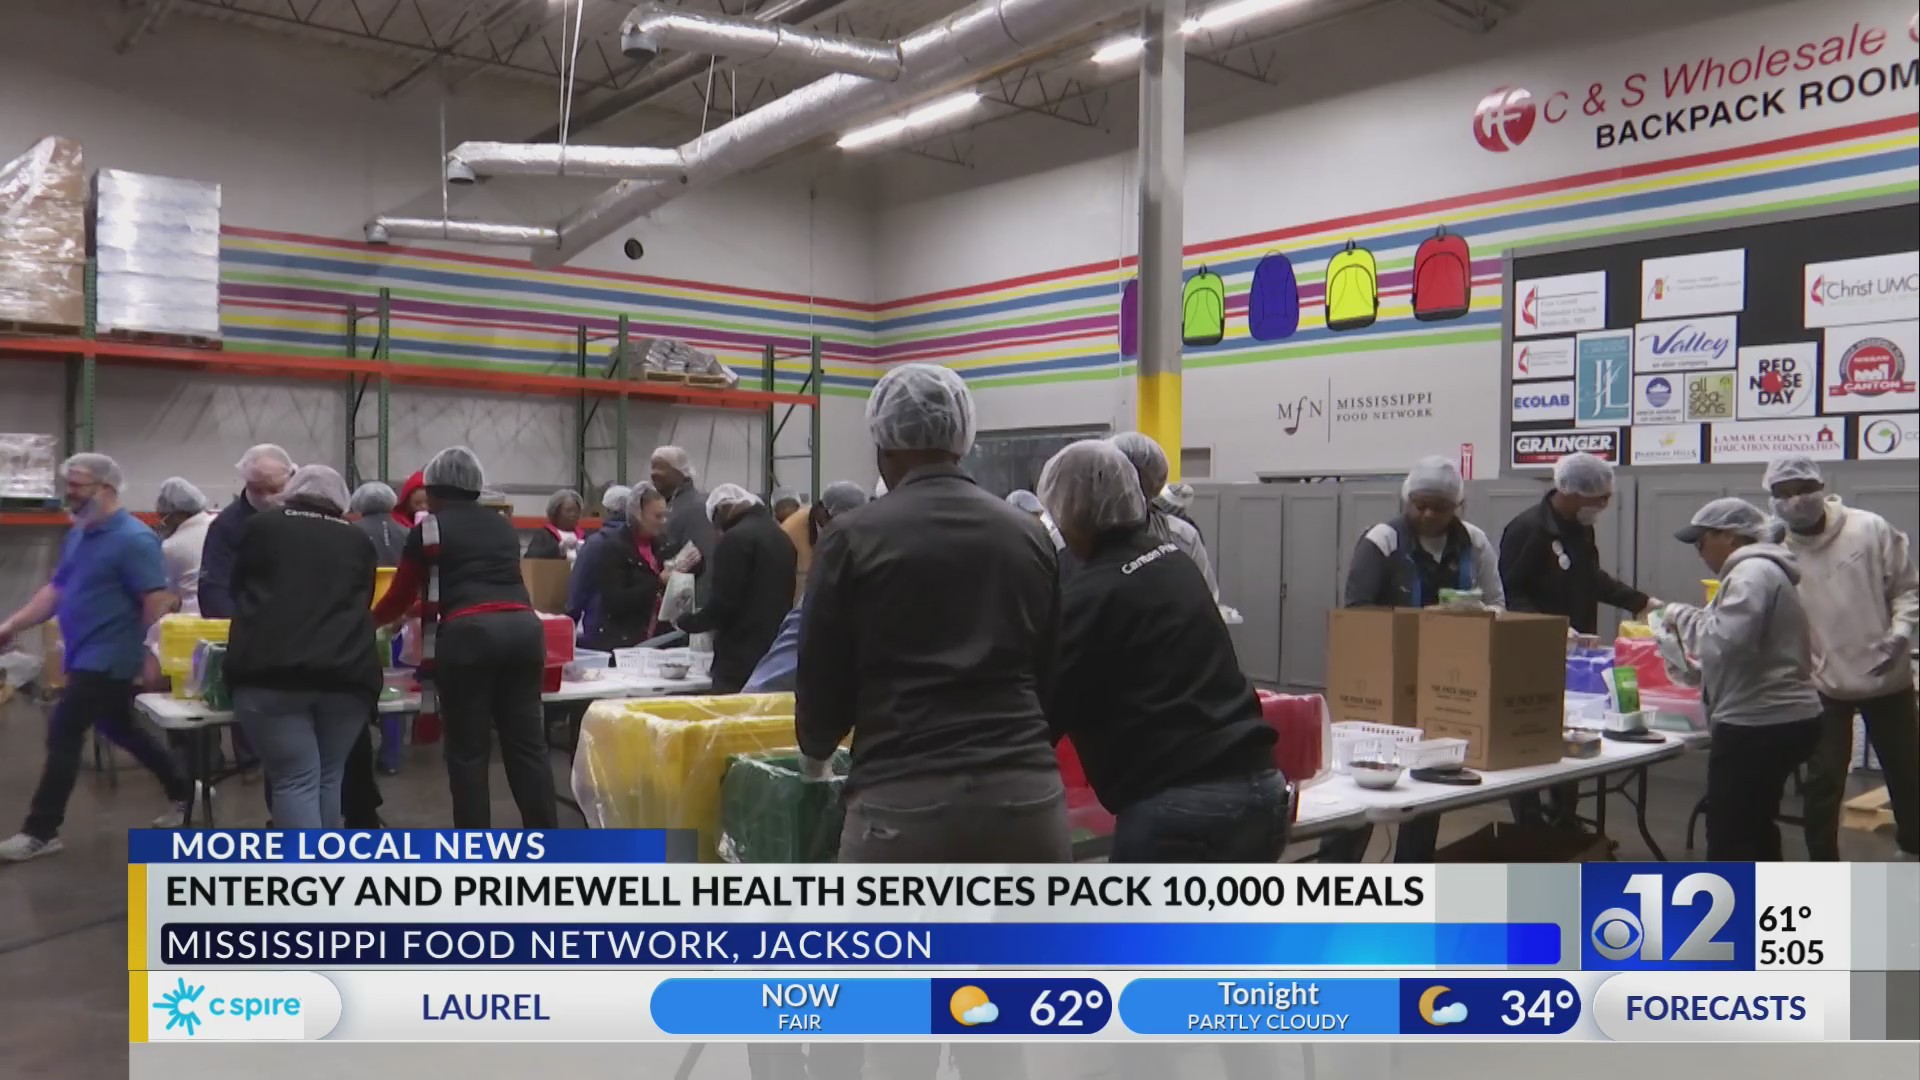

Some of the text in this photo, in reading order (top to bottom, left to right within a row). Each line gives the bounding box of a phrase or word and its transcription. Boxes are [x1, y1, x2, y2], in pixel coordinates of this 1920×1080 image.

[1543, 91, 1569, 124] C
[1582, 82, 1606, 116] &
[1621, 73, 1648, 107] S
[1663, 22, 1887, 98] Wholesale
[1596, 58, 1919, 149] BACKPACK ROOM
[1827, 273, 1919, 300] Christ UMC
[1640, 324, 1729, 360] Valley
[1758, 357, 1796, 375] RED
[1689, 377, 1707, 392] all
[1843, 381, 1901, 392] CANTON
[1336, 391, 1434, 410] MISSISSIPPI
[1513, 394, 1570, 409] ECOLAB
[1758, 388, 1795, 406] DAY
[1336, 407, 1434, 422] FOOD NETWORK
[1516, 434, 1614, 454] GRAINGER
[1714, 432, 1812, 444] LAMAR COUNTY
[1713, 441, 1842, 454] EDUCATION FOUNDATION
